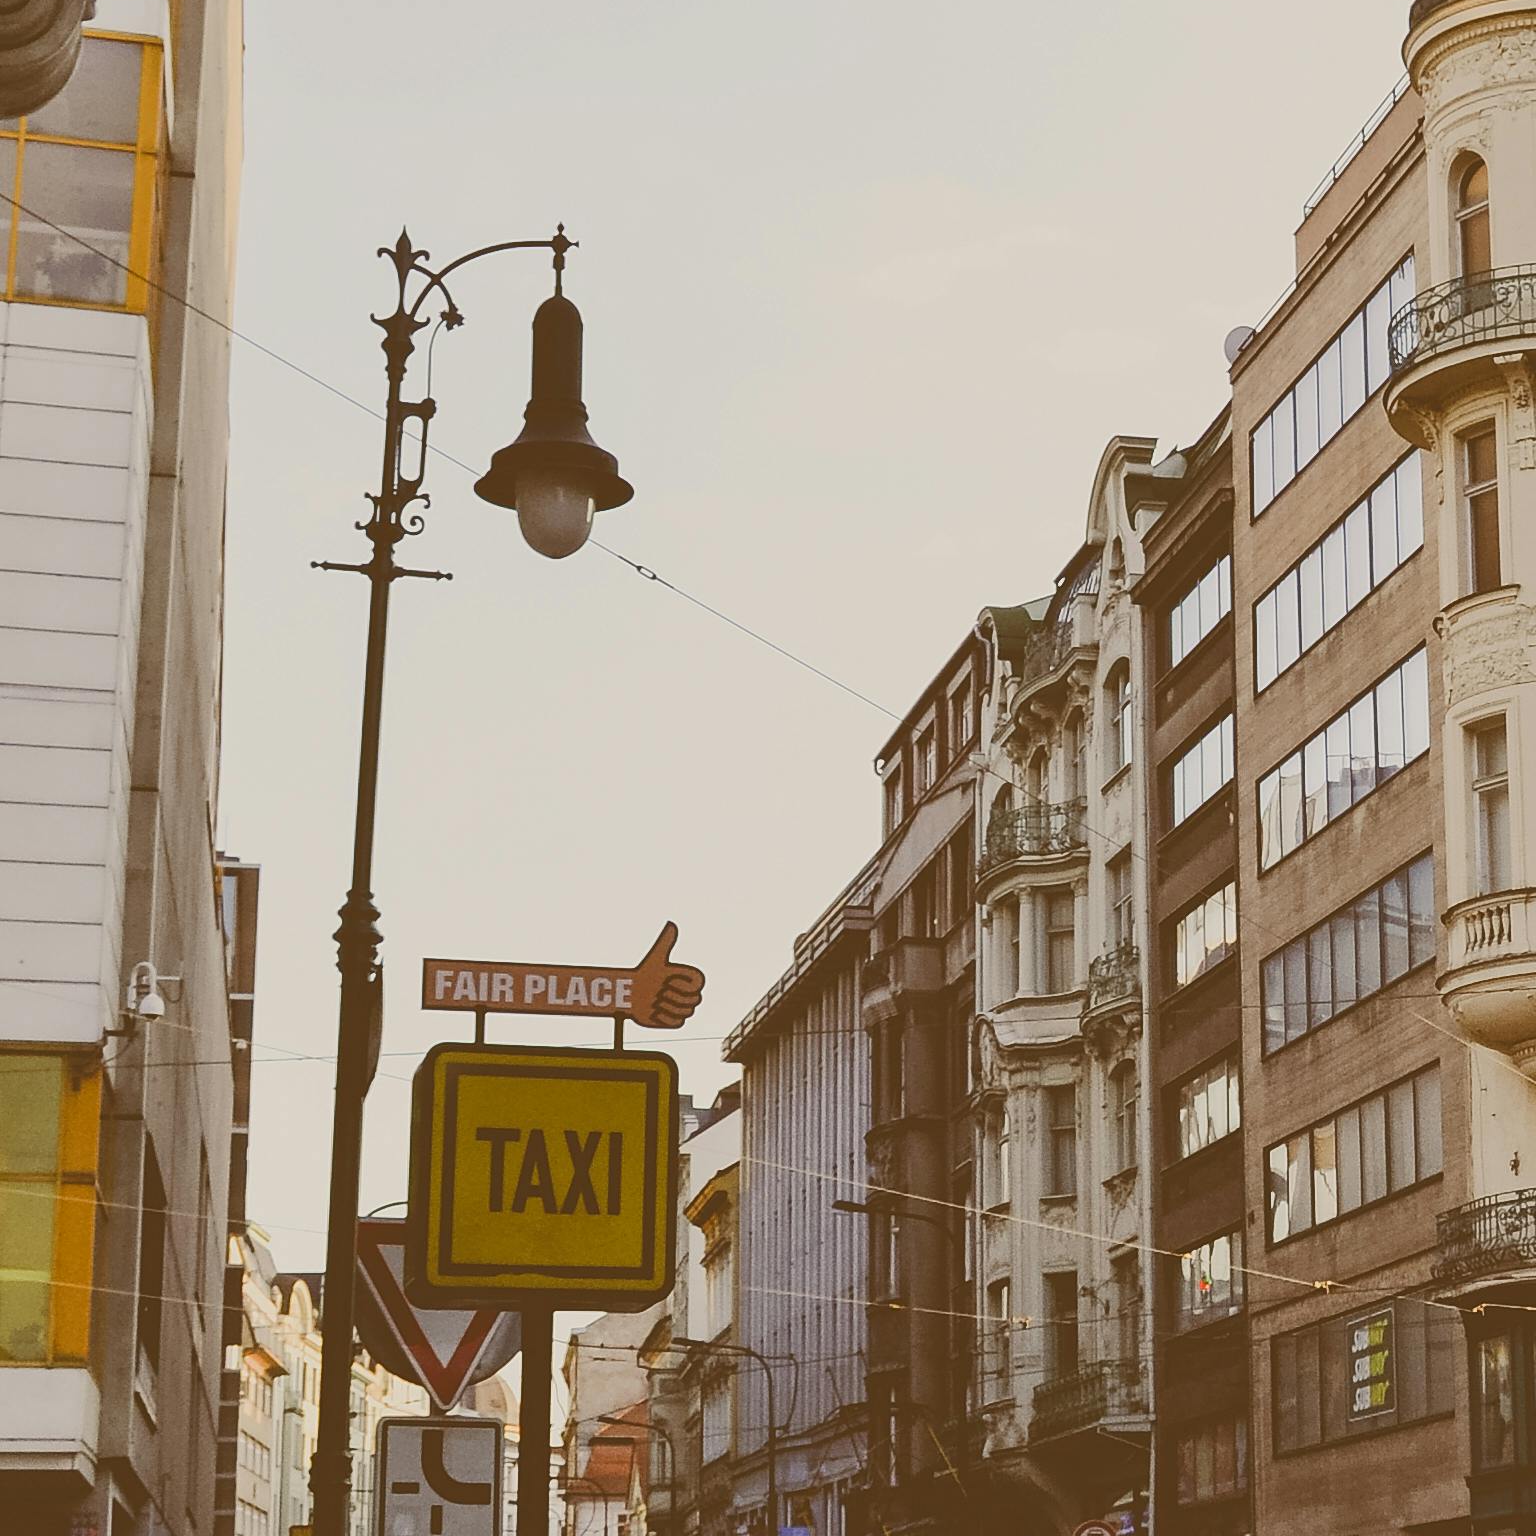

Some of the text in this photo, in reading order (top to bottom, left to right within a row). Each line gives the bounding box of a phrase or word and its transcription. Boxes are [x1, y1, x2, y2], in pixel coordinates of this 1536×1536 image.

[434, 969, 633, 1009] FAIR PLACE
[475, 1126, 623, 1216] TAXI
